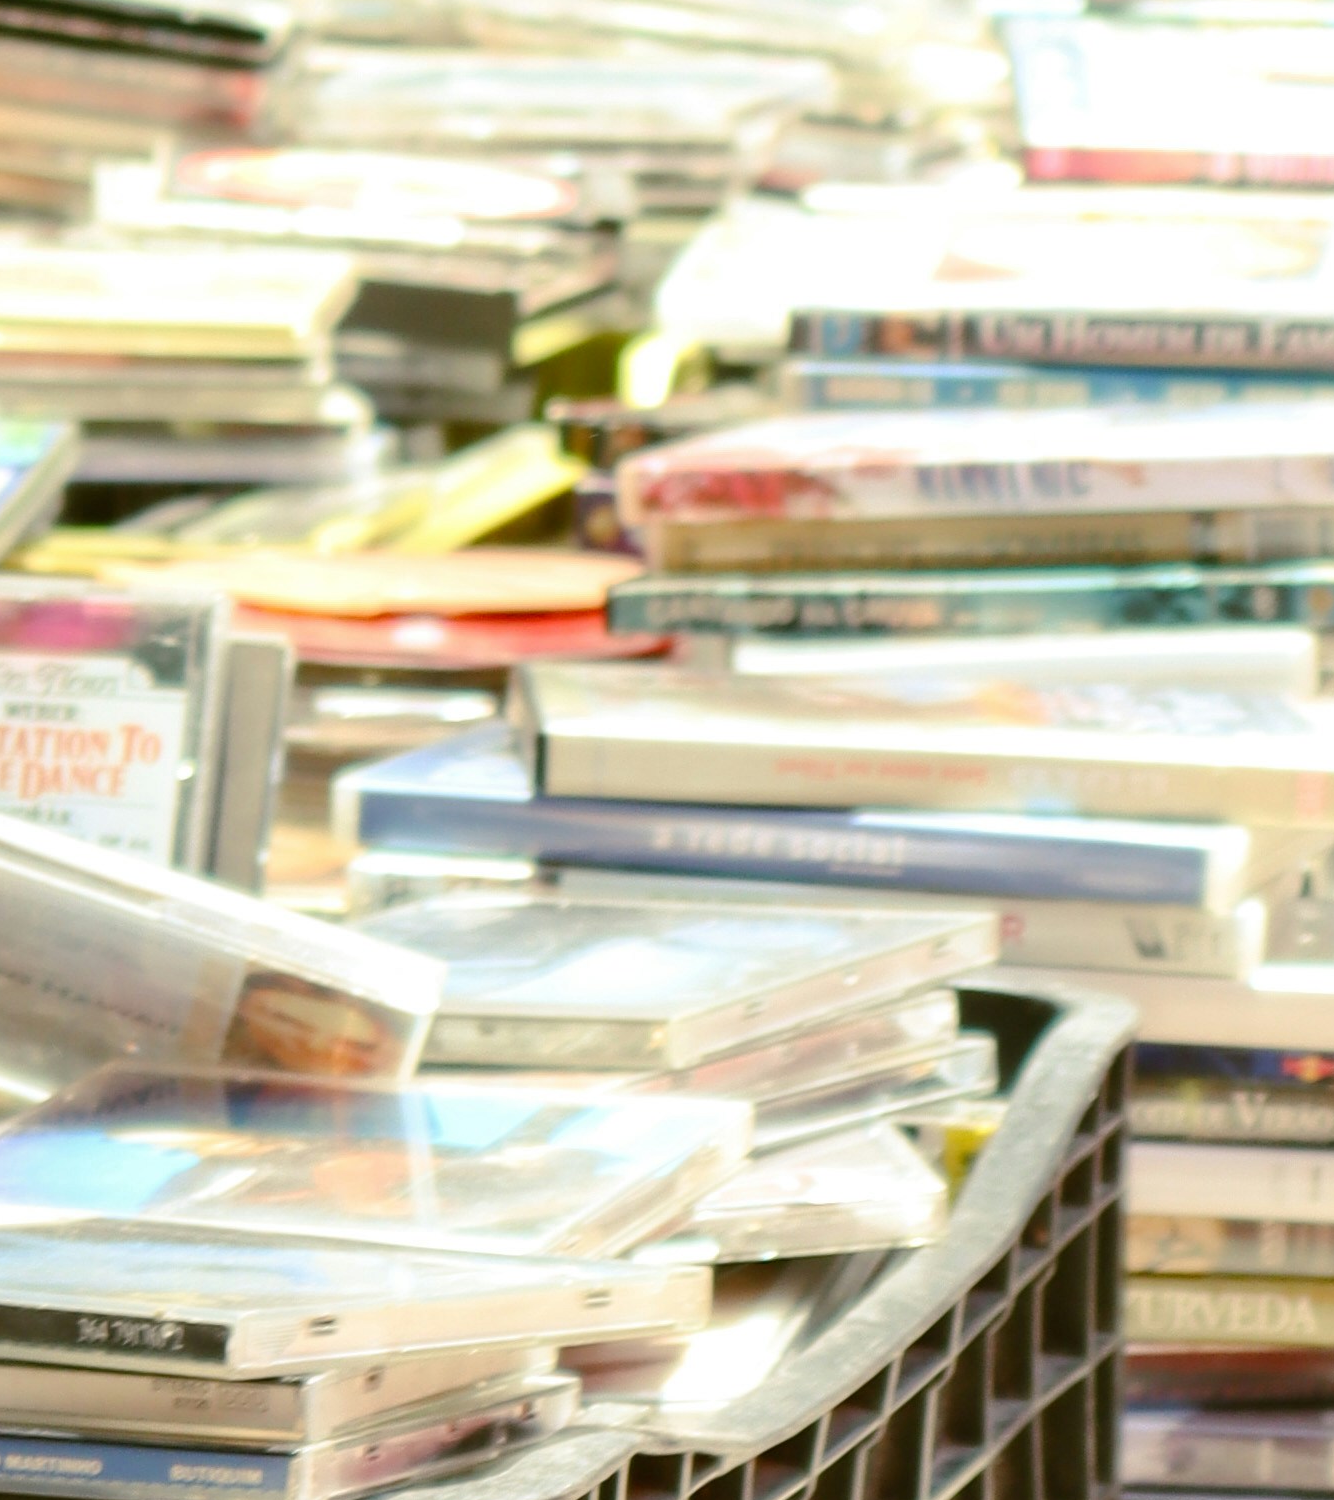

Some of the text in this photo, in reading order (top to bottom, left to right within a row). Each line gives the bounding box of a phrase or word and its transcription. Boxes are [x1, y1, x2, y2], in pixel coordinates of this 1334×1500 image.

[121, 722, 162, 765] TO
[19, 760, 126, 800] DANCE
[789, 832, 905, 867] social
[1125, 1290, 1317, 1334] YURVEDA
[3, 1452, 103, 1477] MARTINHO
[170, 1463, 264, 1486] BUTIQUIM
